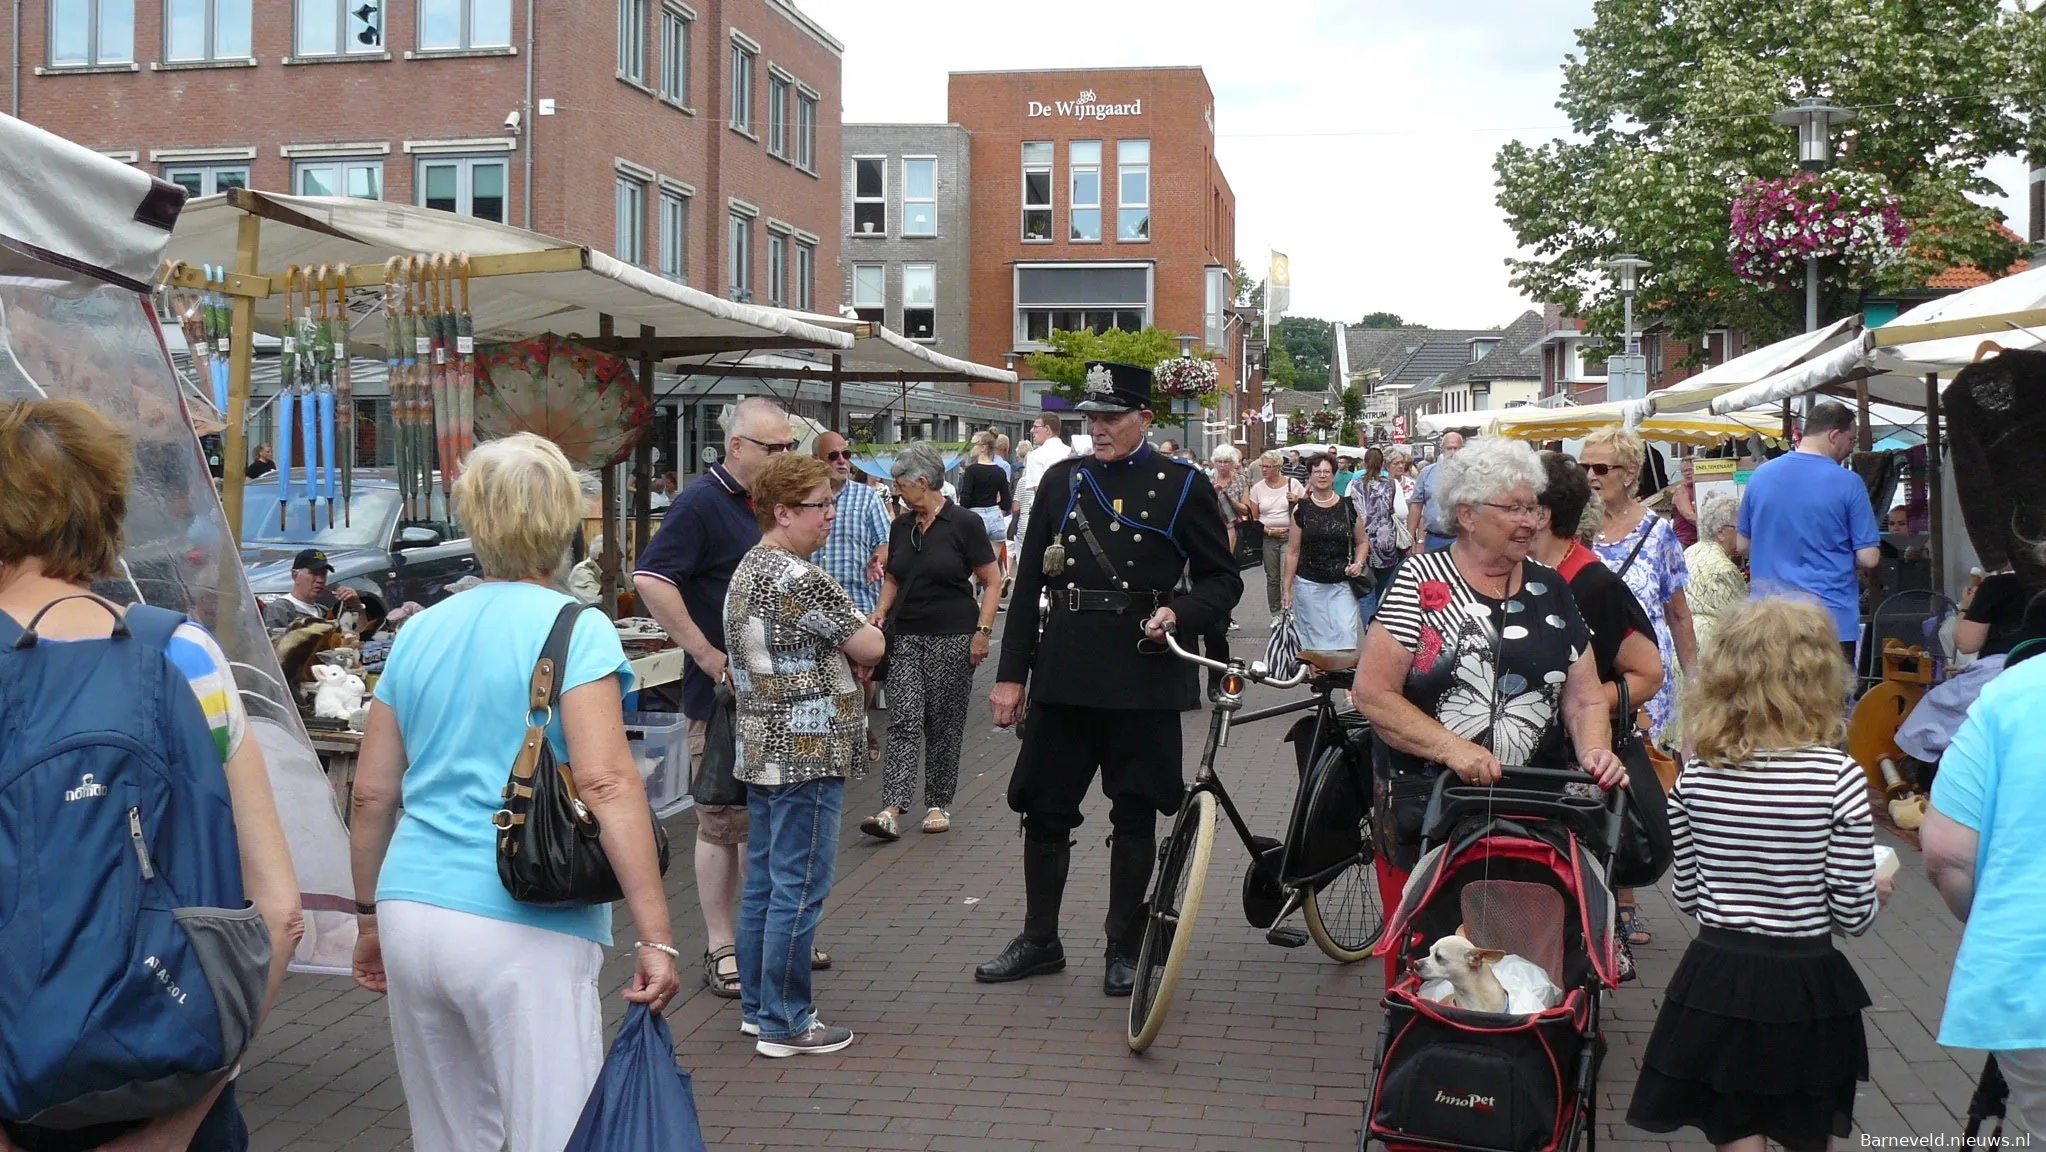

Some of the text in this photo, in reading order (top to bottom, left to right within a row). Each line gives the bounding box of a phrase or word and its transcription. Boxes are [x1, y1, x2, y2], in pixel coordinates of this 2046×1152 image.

[1027, 99, 1142, 121] De Wijngaard
[1395, 416, 1404, 426] 50
[1434, 1090, 1496, 1108] InnoPet
